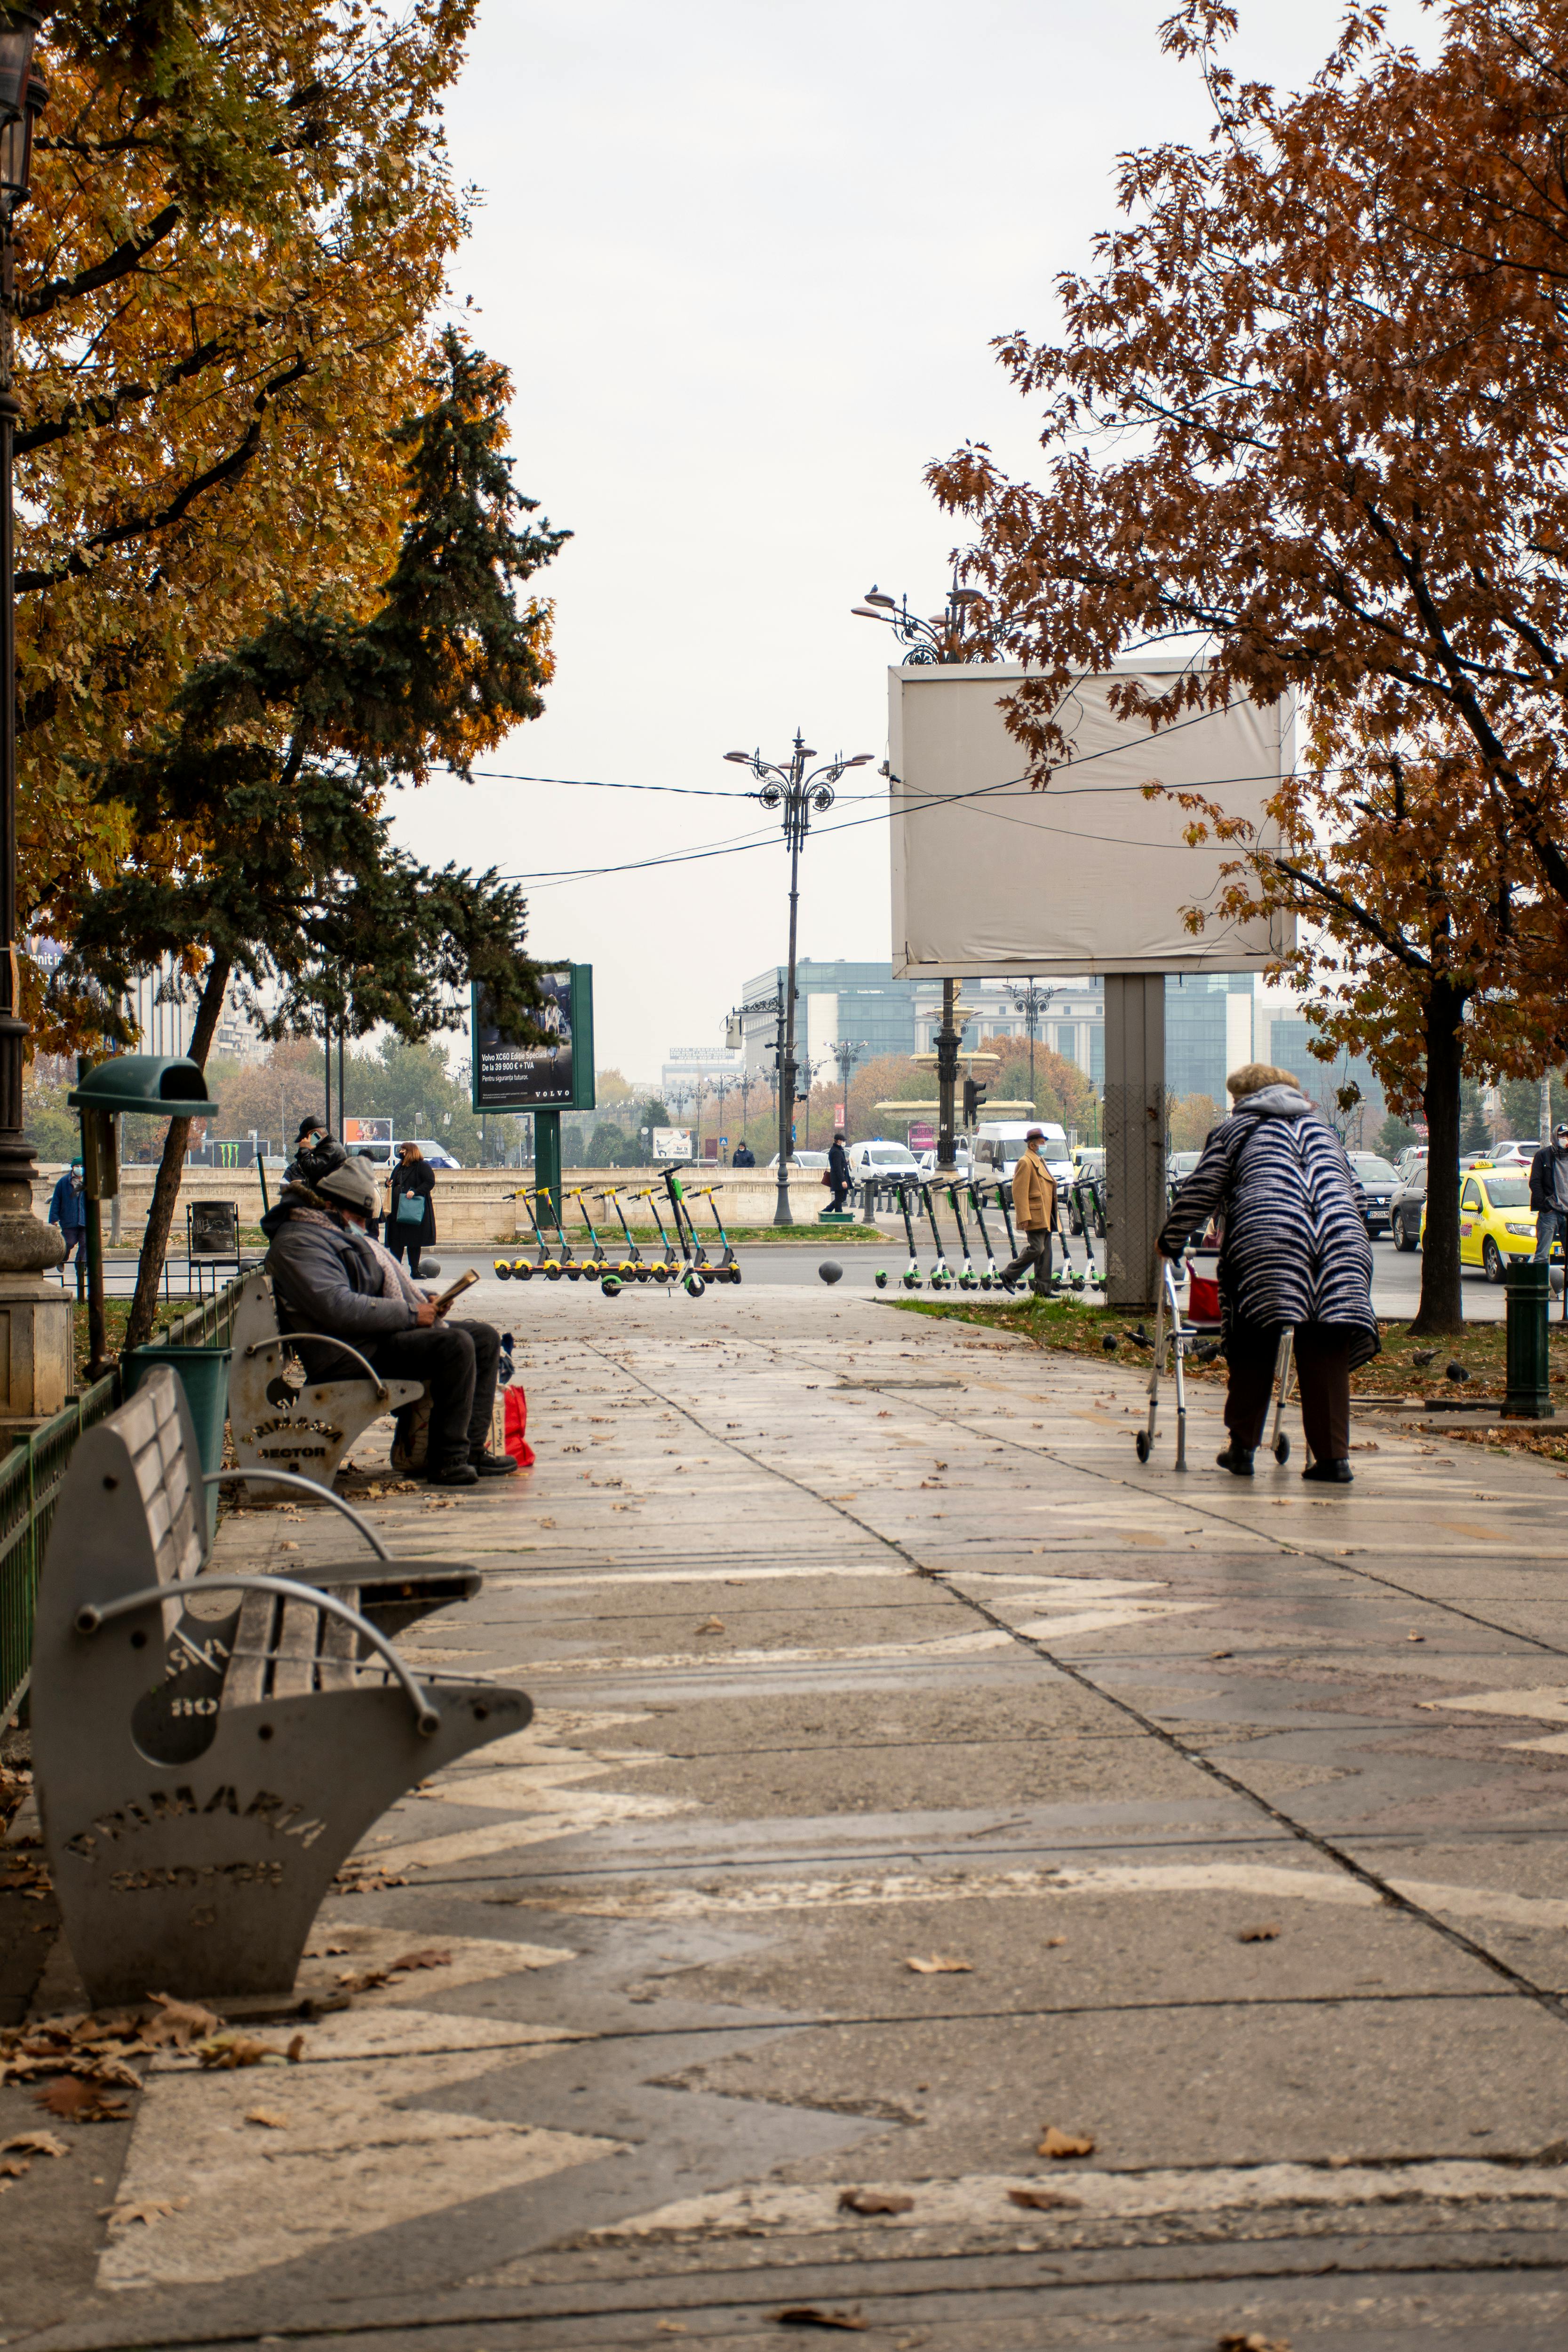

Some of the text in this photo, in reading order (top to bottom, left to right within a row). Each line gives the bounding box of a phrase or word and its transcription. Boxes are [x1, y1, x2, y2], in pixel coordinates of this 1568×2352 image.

[526, 1050, 547, 1060] Specială
[257, 1447, 325, 1459] SECTOR
[288, 1463, 299, 1472] 5
[64, 1785, 326, 1863] PRIMARIA
